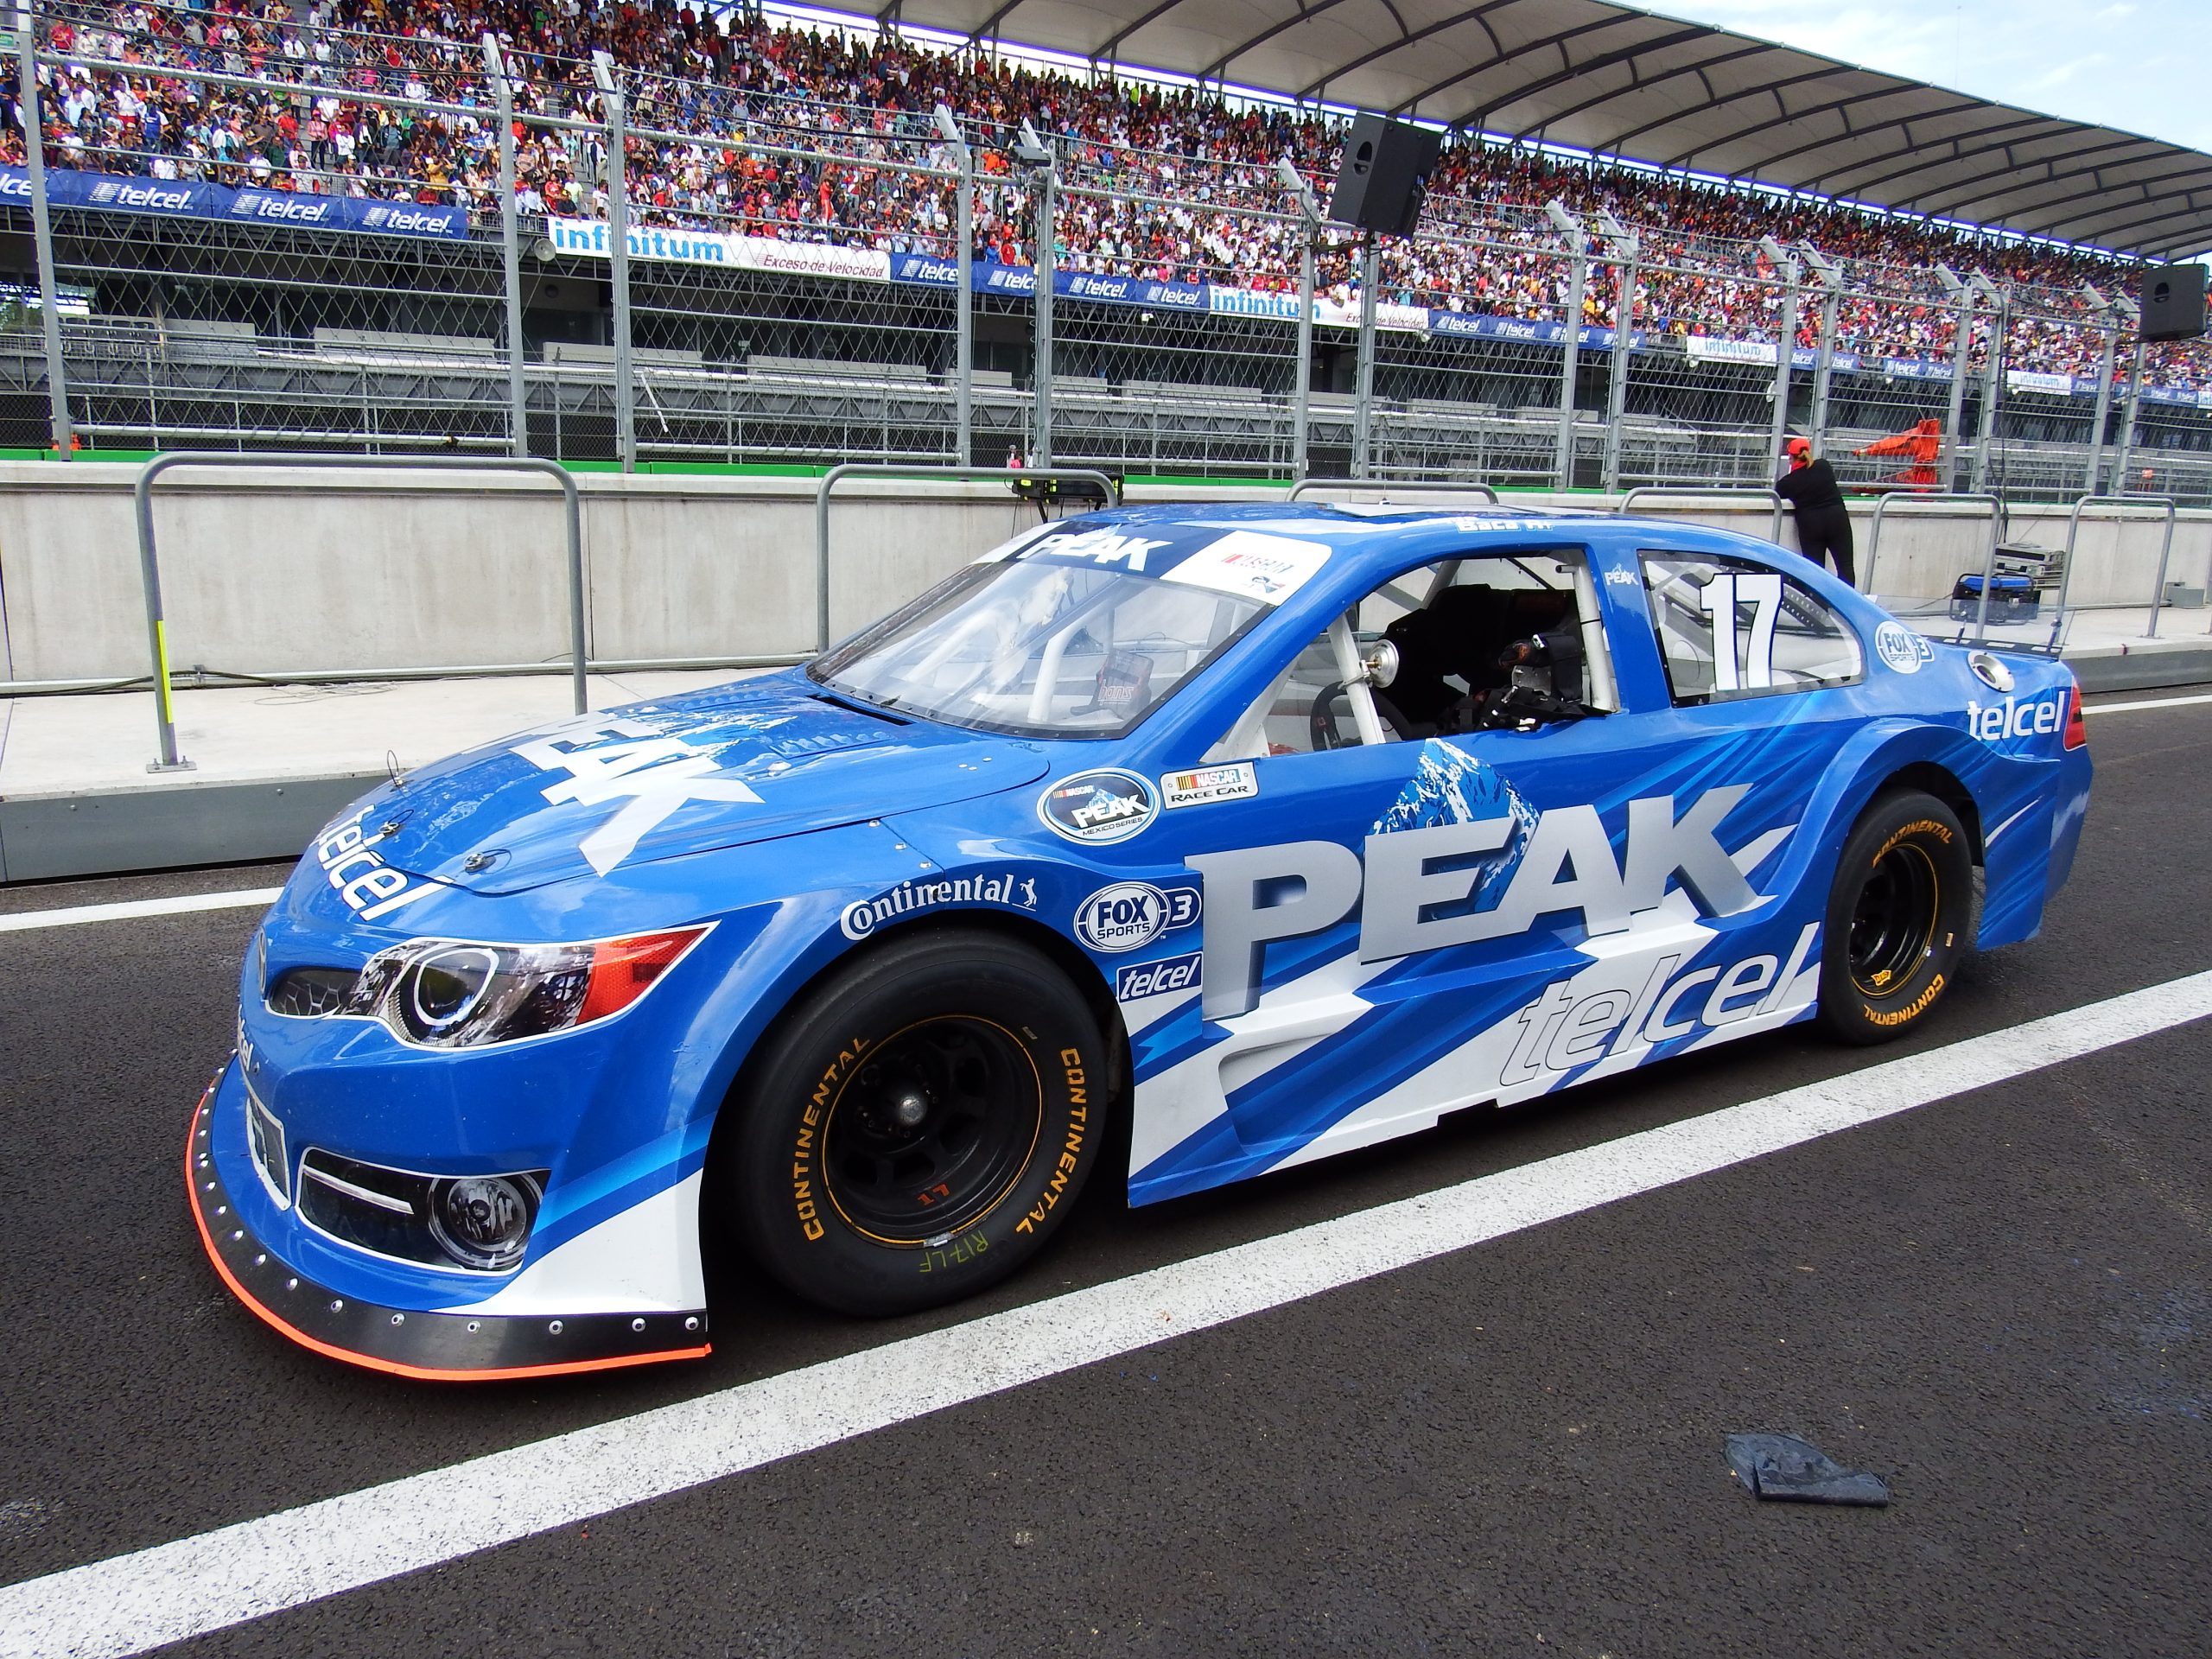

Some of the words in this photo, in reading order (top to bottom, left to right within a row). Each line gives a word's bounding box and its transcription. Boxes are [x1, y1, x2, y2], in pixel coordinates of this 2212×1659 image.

[118, 184, 192, 210] telcel
[257, 198, 327, 222] telcel
[386, 209, 452, 233] telcel
[764, 254, 808, 270] Exceso
[810, 260, 825, 271] de
[829, 261, 884, 277] Velocidad
[918, 261, 959, 282] telce
[1004, 271, 1037, 289] telc
[1085, 278, 1127, 298] telcel
[1160, 287, 1200, 306] telcel
[1447, 316, 1480, 333] telcel
[1506, 322, 1535, 339] telcel
[1016, 533, 1173, 572] PEAK
[1604, 570, 1639, 586] PEAK
[1700, 573, 1783, 691] 17
[1884, 632, 1911, 653] FOX
[1916, 638, 1930, 656] 3
[1967, 690, 2066, 741] telcel
[1196, 768, 1240, 788] NASCAR
[1066, 785, 1096, 798] NASCAR
[1171, 791, 1213, 803] RACE
[1216, 785, 1250, 796] CAR
[1071, 793, 1150, 829] PEAK
[1082, 823, 1116, 836] MEXICO
[1116, 817, 1143, 829] SERIES
[317, 804, 455, 923] telcel
[840, 873, 1014, 942] Continental
[1097, 894, 1148, 929] FOX
[1171, 895, 1191, 922] 3
[1185, 782, 1764, 1021] PEAK
[1096, 921, 1150, 940] SPORTS
[1120, 956, 1201, 1001] telcel
[1500, 921, 1821, 1087] telcel
[1863, 973, 1945, 1026] CONTINENTAL
[793, 1037, 870, 1241] CONTINENTAL
[1015, 1047, 1088, 1235] CONTINENTAL
